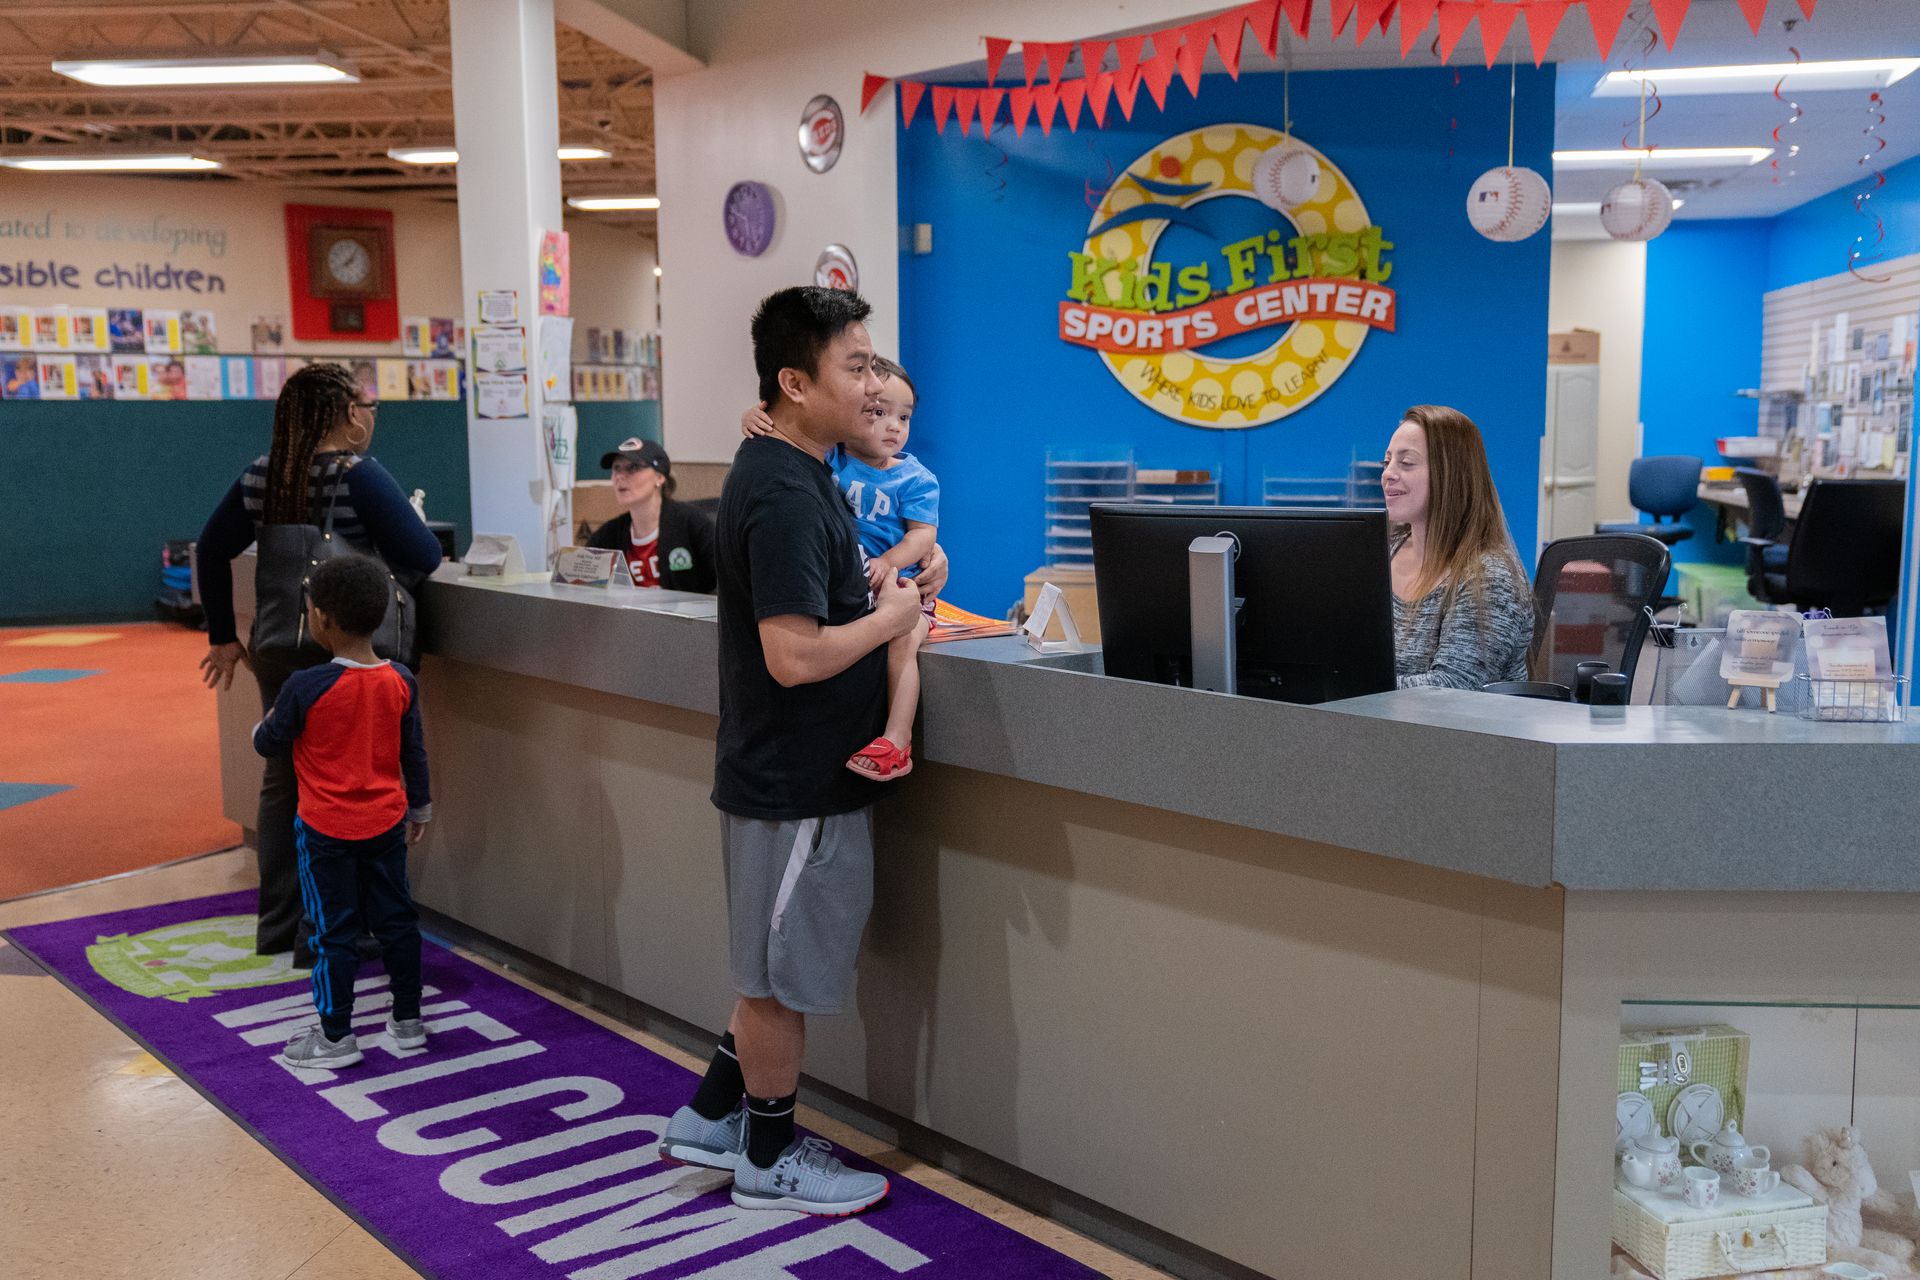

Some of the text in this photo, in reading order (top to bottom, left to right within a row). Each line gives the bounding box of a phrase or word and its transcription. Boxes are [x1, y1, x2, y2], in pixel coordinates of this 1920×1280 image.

[64, 221, 84, 240] to
[96, 217, 228, 257] developing
[0, 260, 225, 293] sible children
[1067, 225, 1394, 312] Kids First
[1064, 284, 1392, 348] SPORTS CENTER
[1140, 362, 1184, 401] WHERE
[1187, 391, 1218, 411] KIDS
[1221, 394, 1256, 411] LOVE
[1261, 387, 1281, 404] TO
[832, 481, 890, 521] AP
